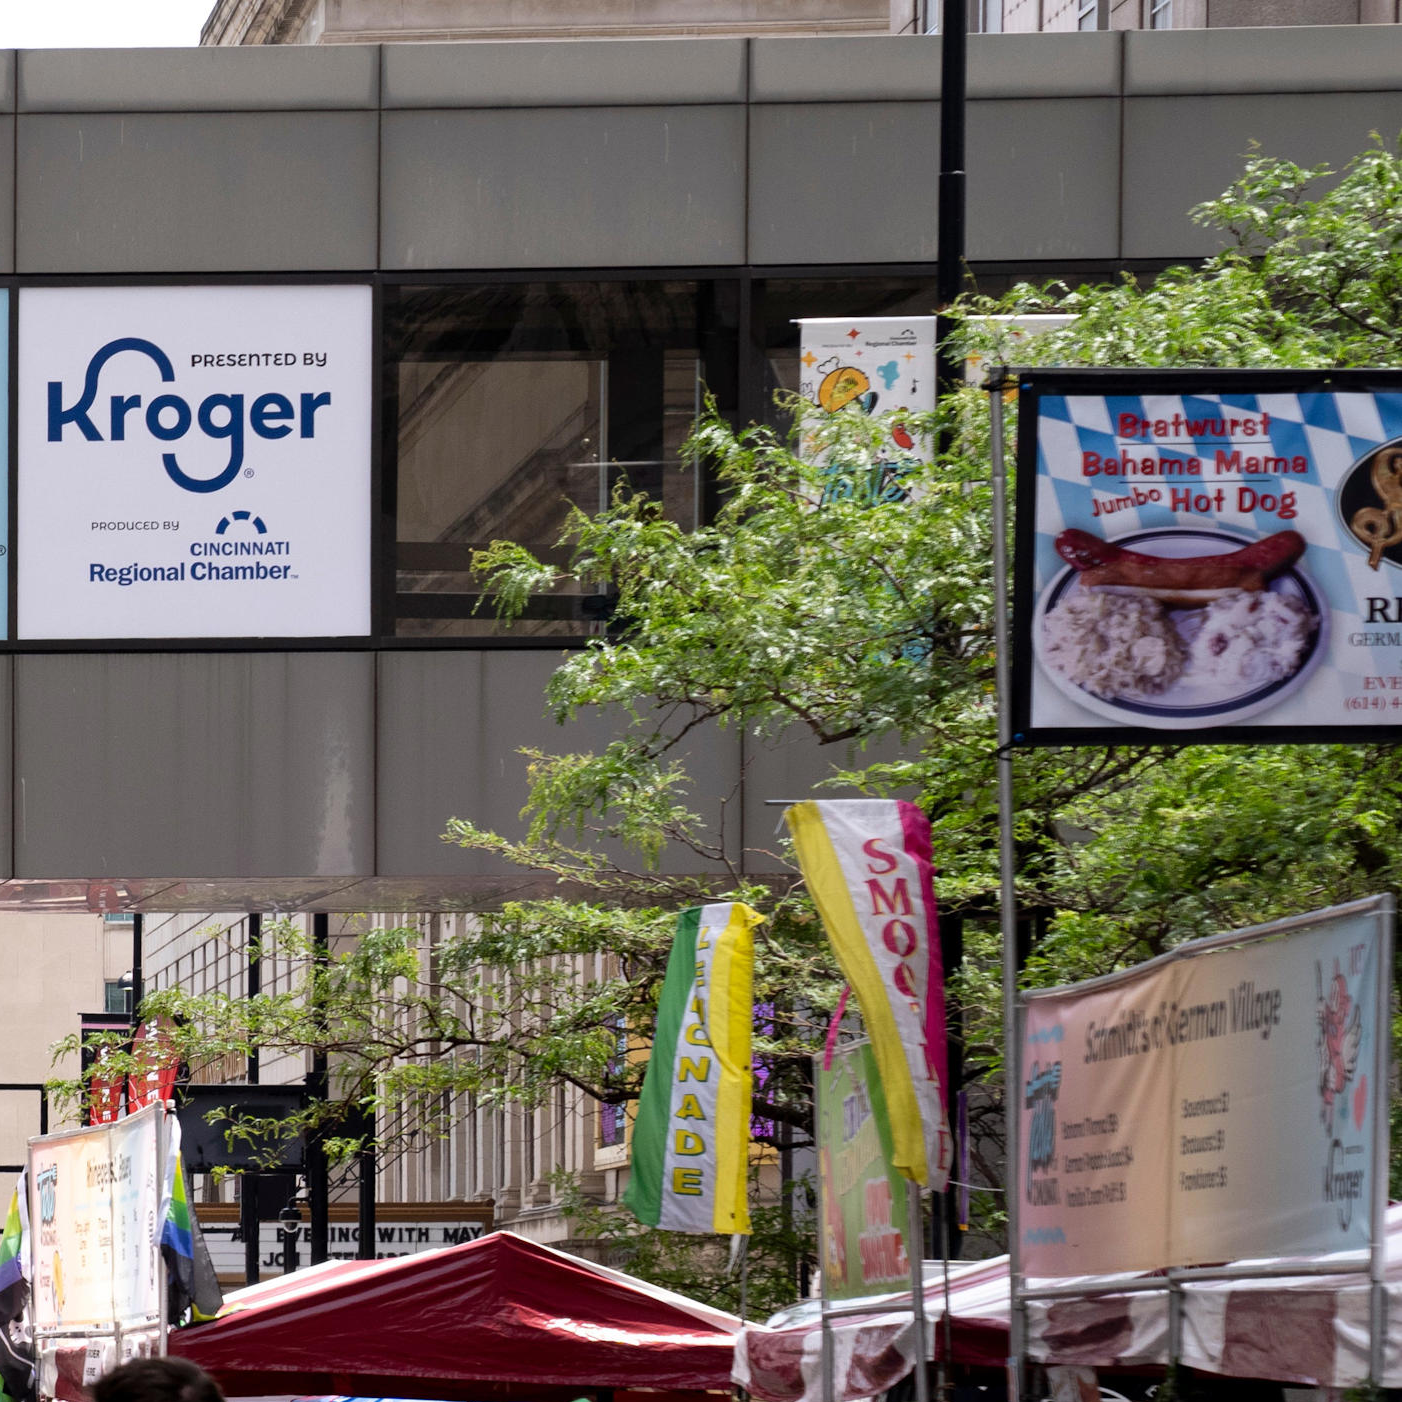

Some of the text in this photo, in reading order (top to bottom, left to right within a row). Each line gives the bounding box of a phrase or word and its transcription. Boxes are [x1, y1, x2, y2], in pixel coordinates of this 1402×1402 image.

[191, 352, 328, 368] PRESENTED BY
[47, 336, 332, 494] Kroger
[1117, 412, 1272, 439] Bratwurst
[1081, 452, 1309, 478] Bahama Mama
[1092, 486, 1298, 519] Jumbo Hot Dog
[90, 521, 180, 531] PRODUCED BY
[189, 541, 291, 557] CINCINNATI
[89, 562, 186, 586] Regional
[1229, 981, 1283, 1042] Village
[378, 1227, 430, 1243] WITH
[443, 1227, 483, 1243] MAY
